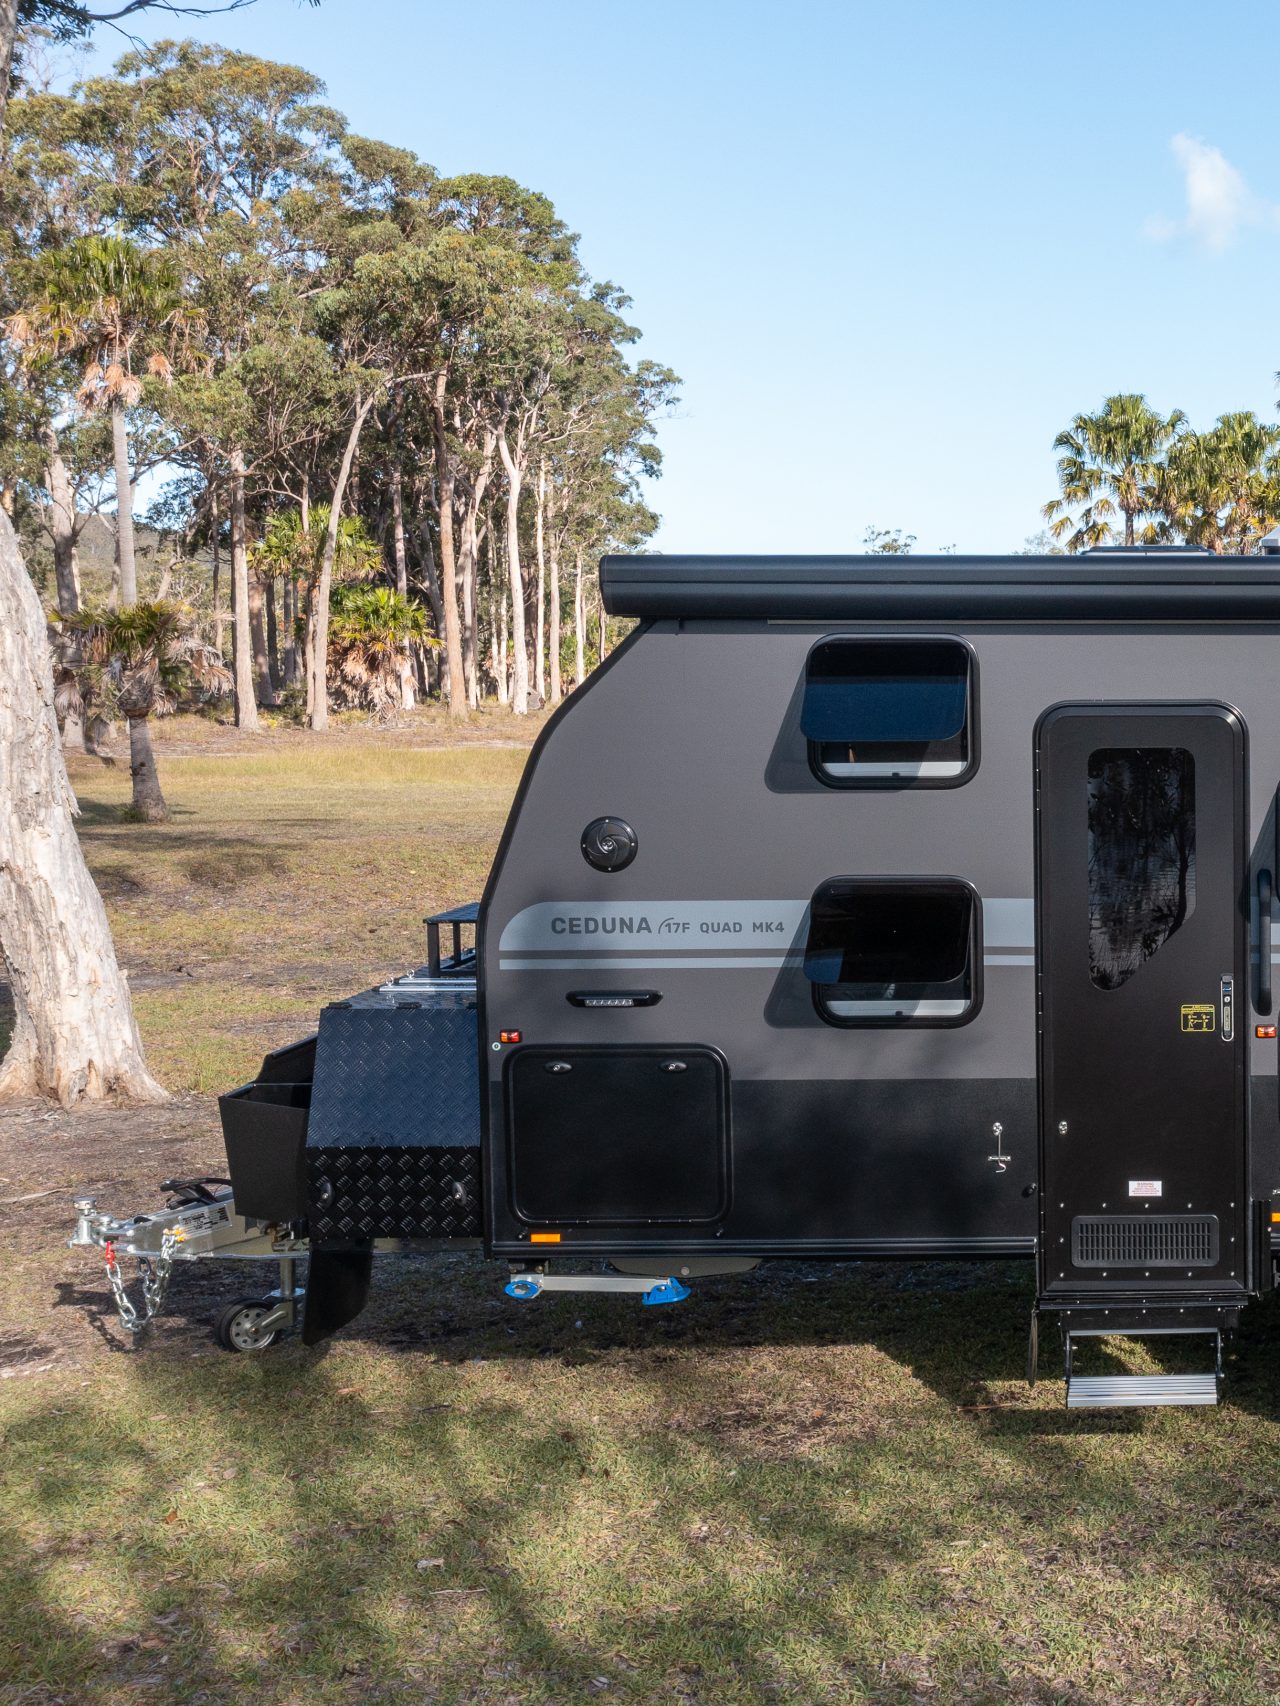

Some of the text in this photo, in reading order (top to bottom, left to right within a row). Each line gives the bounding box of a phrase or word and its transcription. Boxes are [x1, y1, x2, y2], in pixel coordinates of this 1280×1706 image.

[550, 916, 785, 934] CEDUNA 17F QUAD MK4
